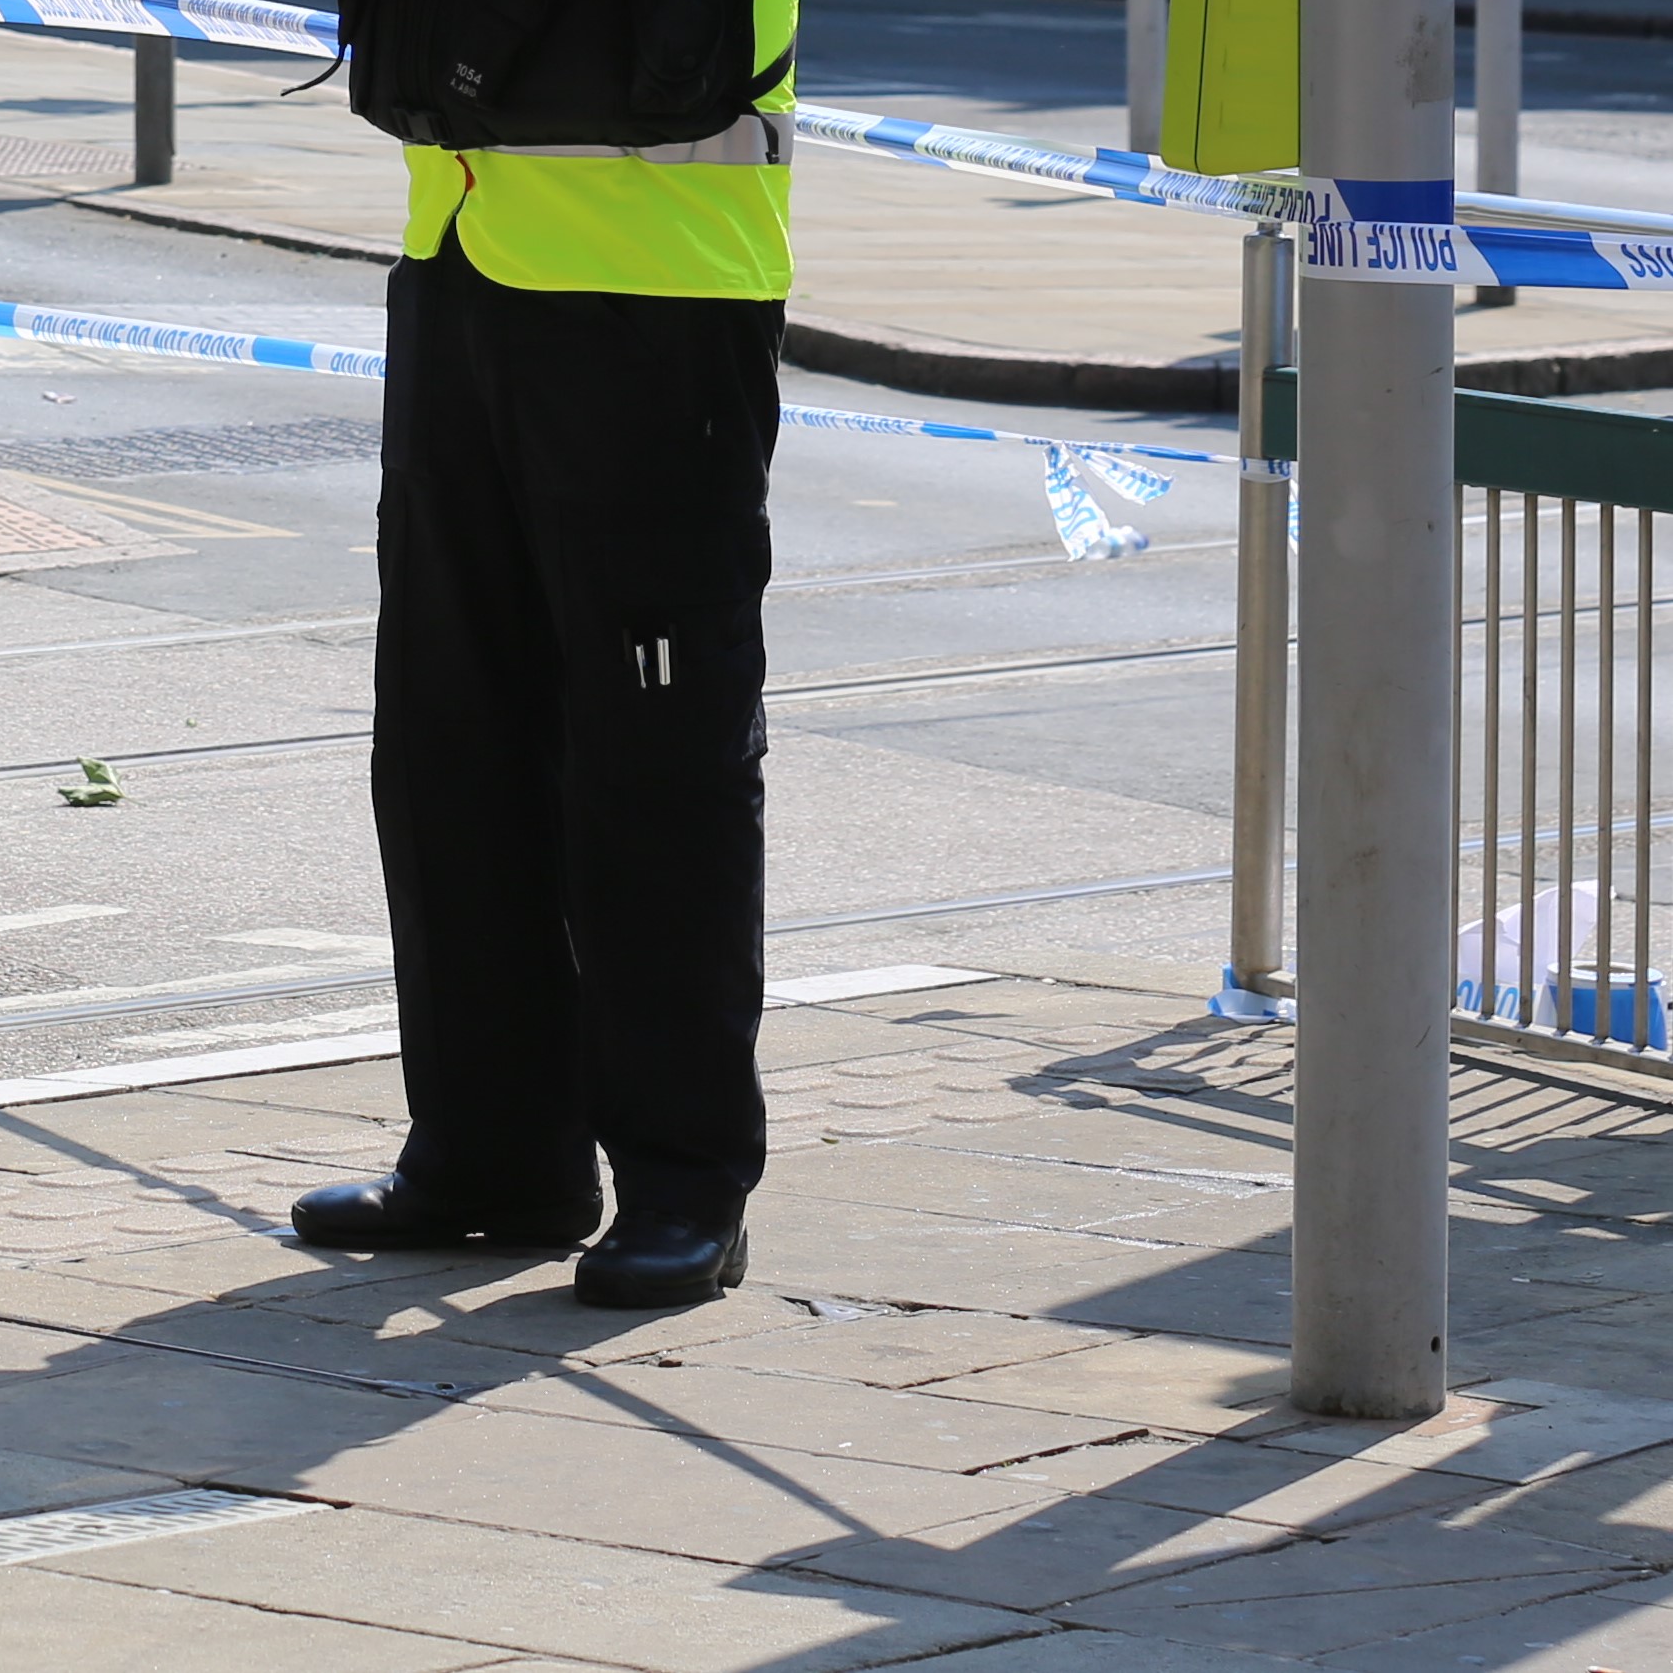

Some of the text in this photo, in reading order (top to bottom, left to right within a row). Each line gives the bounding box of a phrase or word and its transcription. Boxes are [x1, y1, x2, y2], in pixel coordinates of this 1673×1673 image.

[456, 63, 482, 85] 1054
[1307, 224, 1458, 272] POLICE LINE
[31, 314, 246, 362] POLICE LINE DO NOT CROSS
